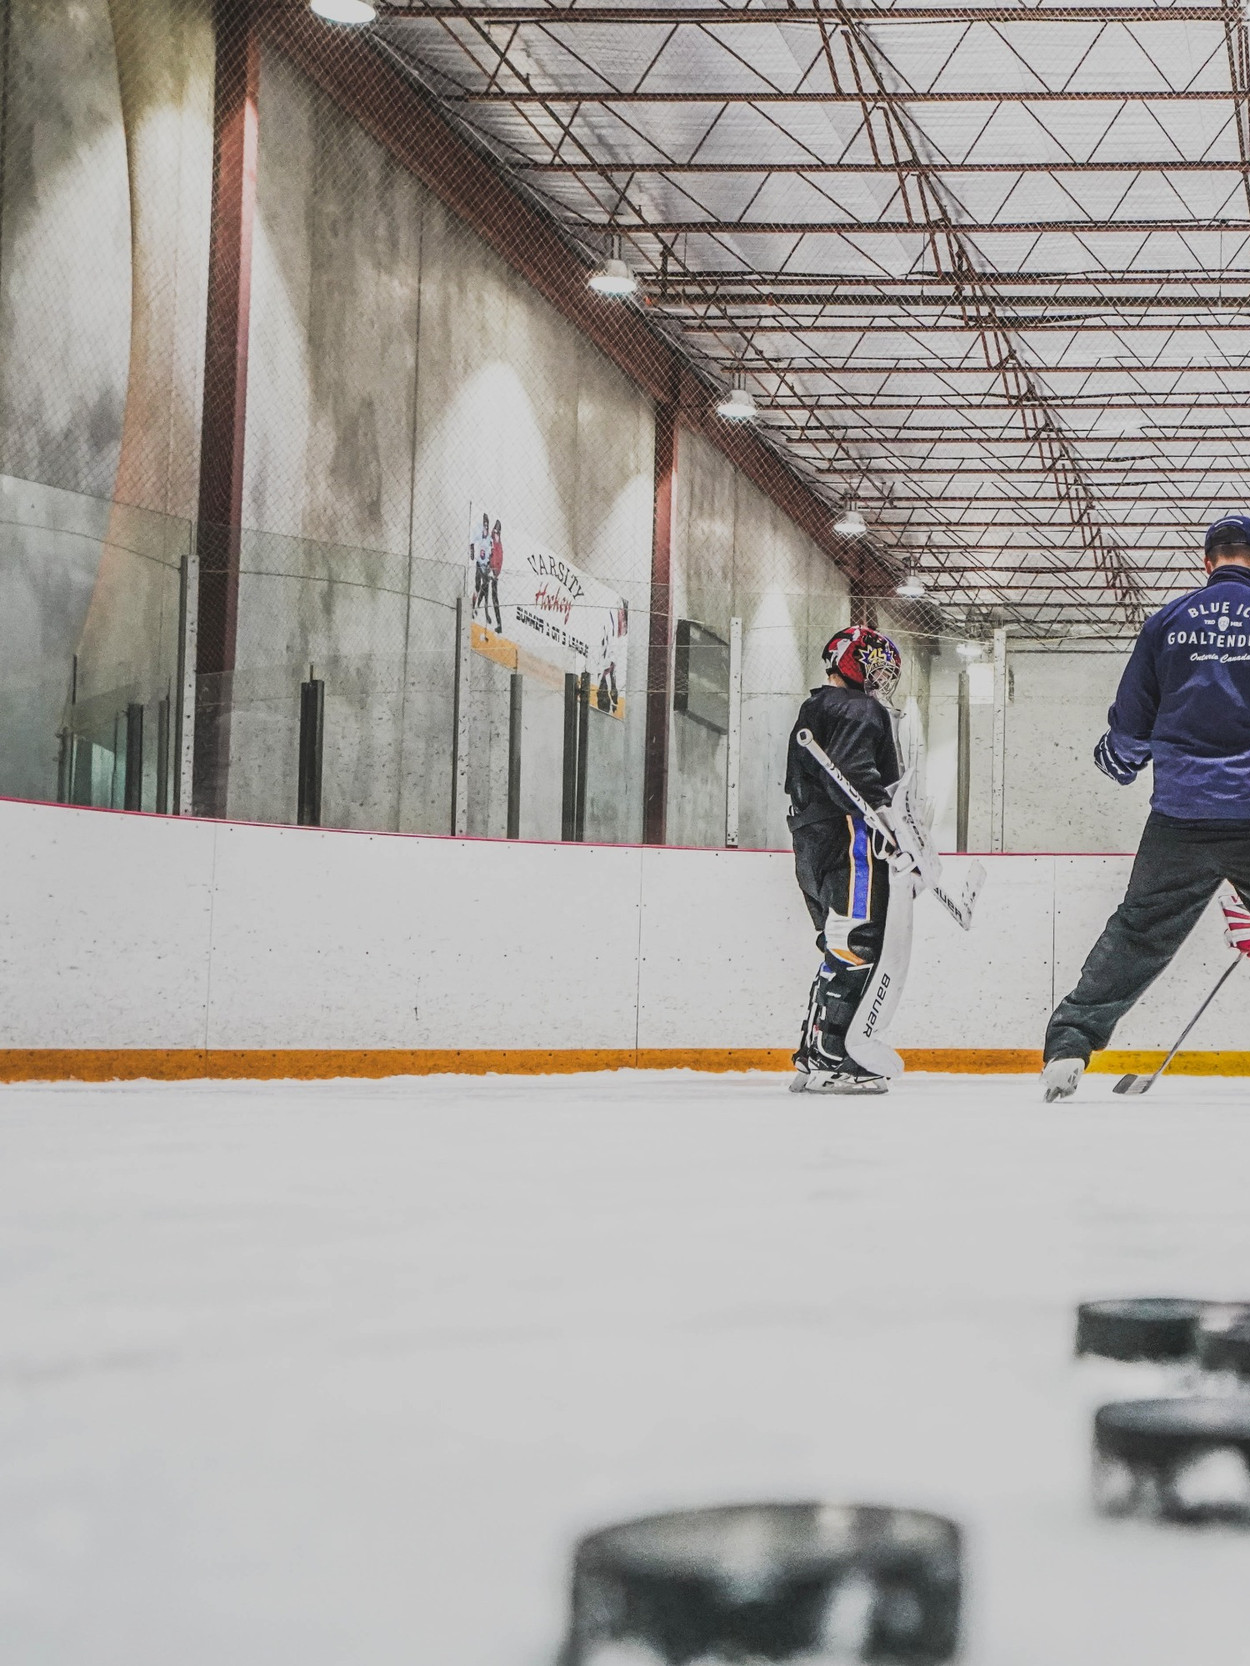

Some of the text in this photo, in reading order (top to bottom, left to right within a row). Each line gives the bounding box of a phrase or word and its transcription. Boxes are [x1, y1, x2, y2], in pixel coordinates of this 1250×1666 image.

[527, 554, 584, 599] VARSITY
[535, 582, 572, 625] Hockey
[1188, 602, 1230, 618] BLUE
[515, 606, 544, 634] SUMMER
[1190, 653, 1250, 664] Ontario Canada
[933, 887, 963, 922] AUER
